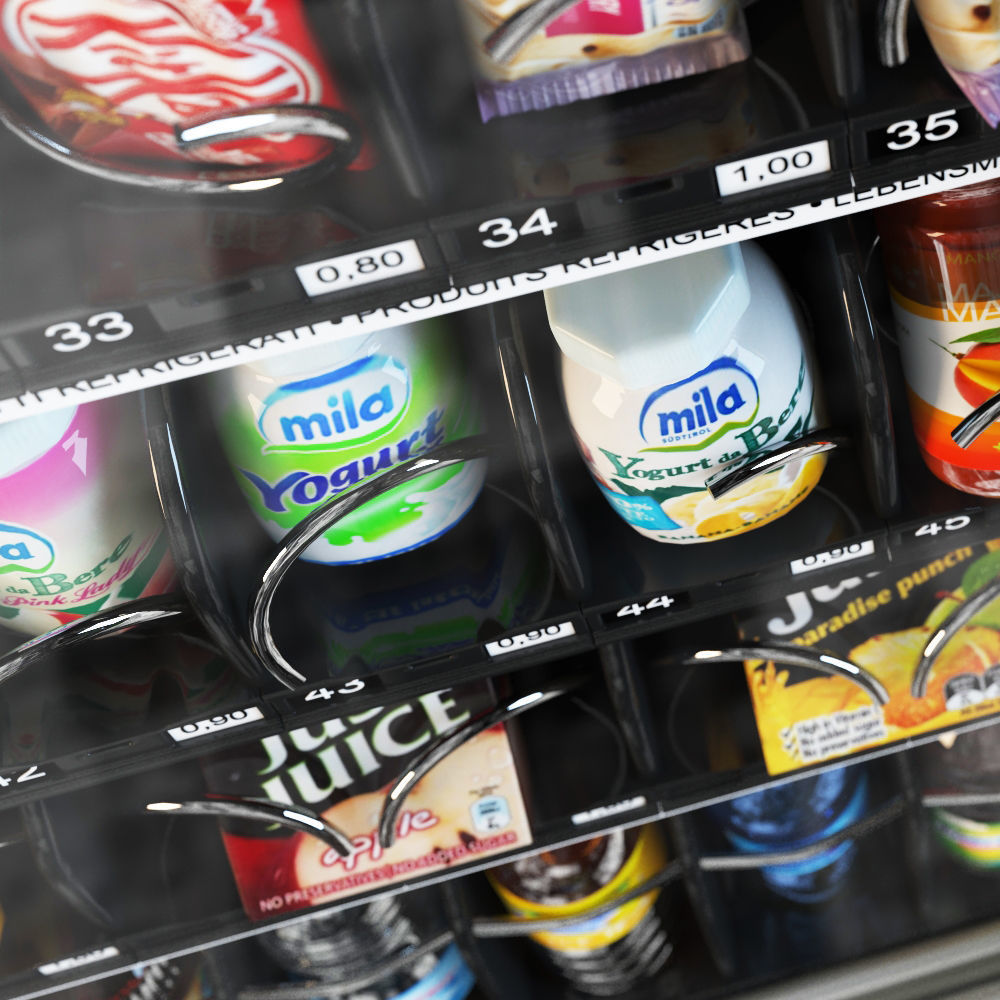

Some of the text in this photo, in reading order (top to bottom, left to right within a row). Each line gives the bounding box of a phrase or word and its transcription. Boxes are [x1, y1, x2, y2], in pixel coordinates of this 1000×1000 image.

[885, 108, 960, 152] 35
[733, 149, 815, 182] 1,00
[477, 206, 559, 249] 34
[315, 249, 405, 285] 0,80
[44, 310, 135, 353] 33
[279, 384, 394, 442] mila
[657, 382, 747, 437] mila
[237, 407, 446, 513] Yogurt
[598, 447, 713, 481] Yogurt
[717, 449, 743, 465] da
[5, 585, 31, 595] da
[259, 896, 284, 912] NO
